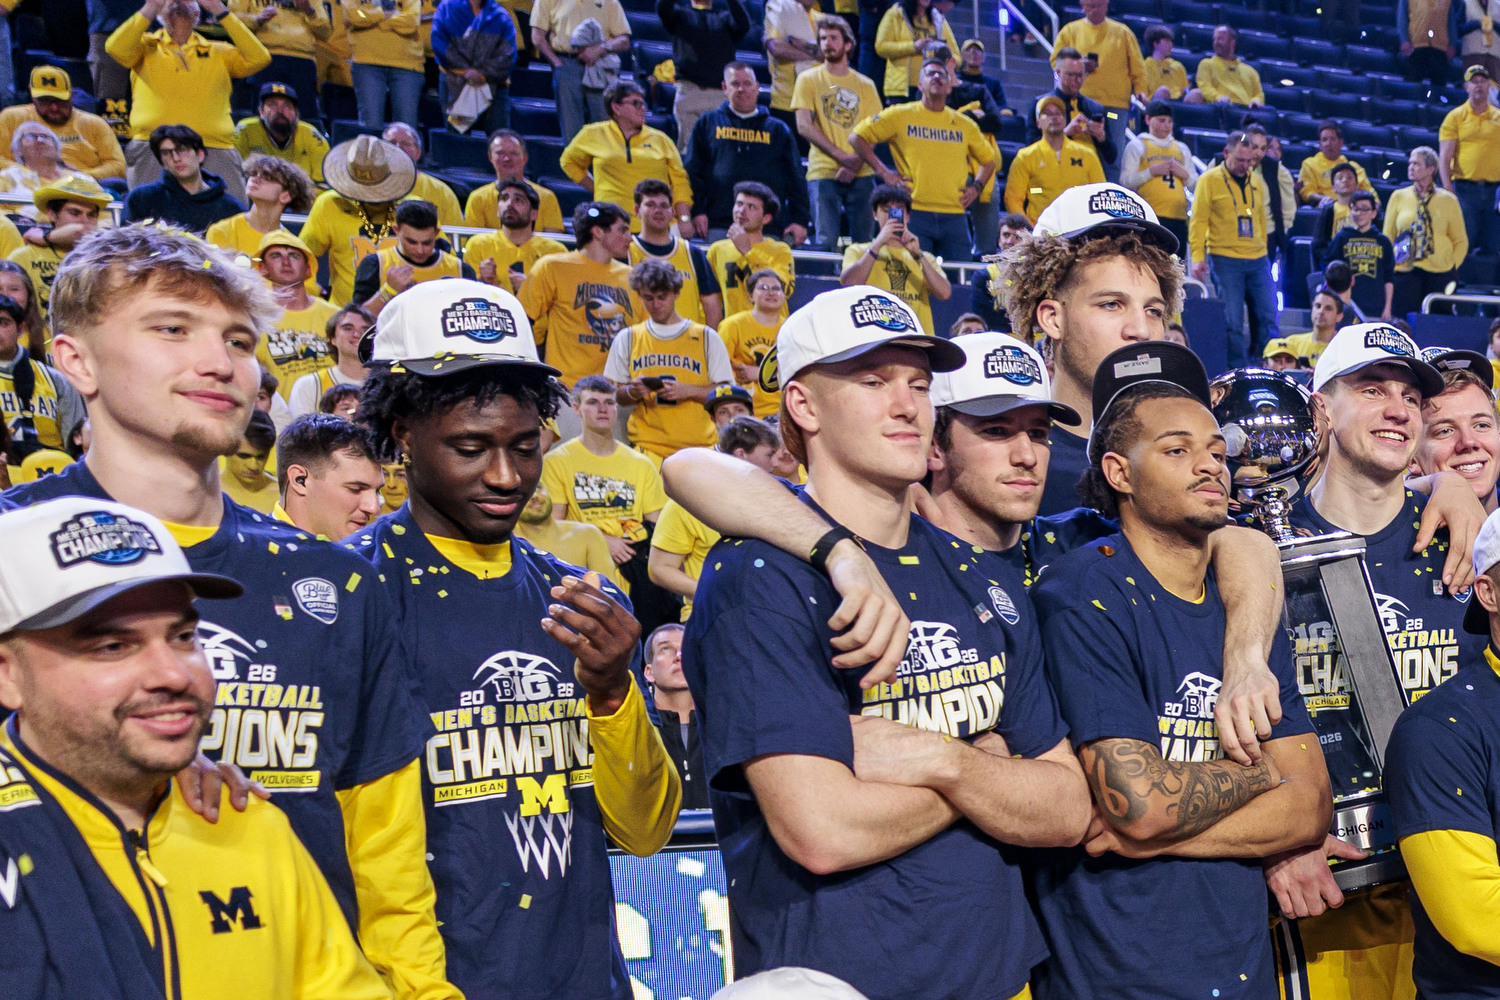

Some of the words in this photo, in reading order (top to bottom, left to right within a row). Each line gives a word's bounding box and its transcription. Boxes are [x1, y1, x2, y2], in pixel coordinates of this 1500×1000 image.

[716, 125, 771, 145] MICHIGAN
[907, 123, 964, 144] MICHIGAN
[1162, 170, 1176, 190] 4
[1092, 200, 1146, 220] CHAMPIONS
[445, 317, 515, 333] CHAMPIONS
[855, 310, 916, 328] CHAMPIONS
[1367, 337, 1414, 358] CHAMPIONS
[633, 354, 702, 374] MICHIGAN
[988, 361, 1040, 379] CHAMPIONS
[59, 532, 160, 565] CHAMPIONS
[1405, 618, 1424, 631] 26
[1390, 628, 1458, 652] KETBALL
[961, 649, 979, 665] 26
[247, 664, 278, 682] 26
[215, 682, 324, 710] KETBALL
[460, 689, 486, 708] 20
[557, 681, 576, 699] 26
[504, 697, 587, 725] BASKETBA
[1164, 702, 1183, 717] 20
[200, 709, 325, 768] PIONS
[1320, 732, 1342, 745] 026
[256, 774, 314, 786] WOLVERINES
[438, 782, 505, 799] MICHIGAN
[515, 772, 572, 817] M
[198, 885, 263, 935] M
